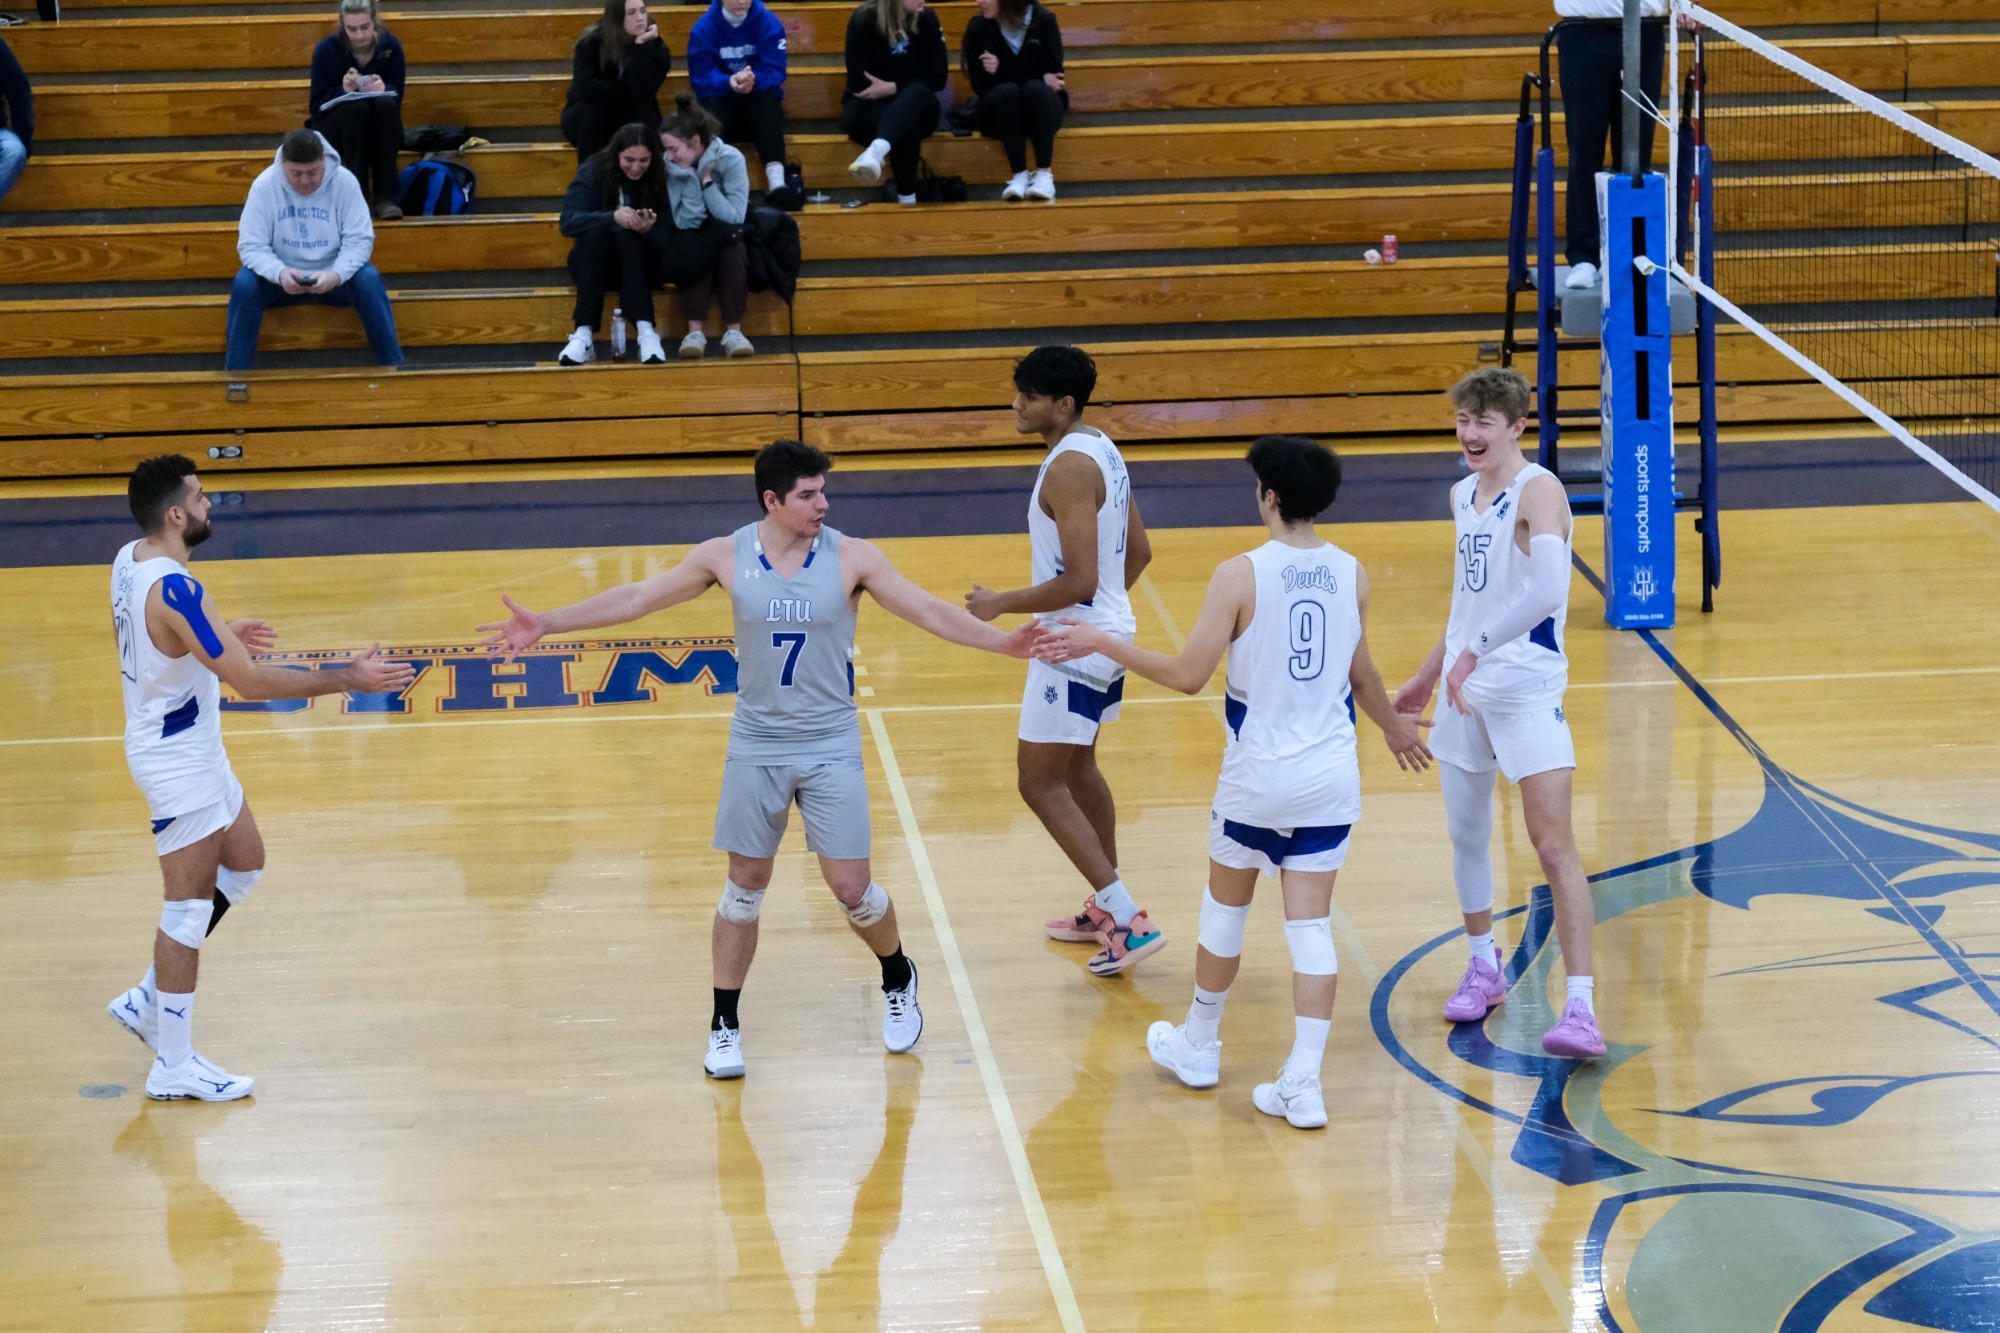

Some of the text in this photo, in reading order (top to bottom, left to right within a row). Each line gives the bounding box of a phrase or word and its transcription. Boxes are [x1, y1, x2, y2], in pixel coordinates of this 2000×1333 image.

[1634, 444, 1651, 554] sports imports
[1281, 564, 1338, 594] Devils
[1458, 533, 1492, 593] 15
[765, 597, 812, 623] LTU
[771, 631, 807, 688] 7
[1289, 600, 1326, 681] 9
